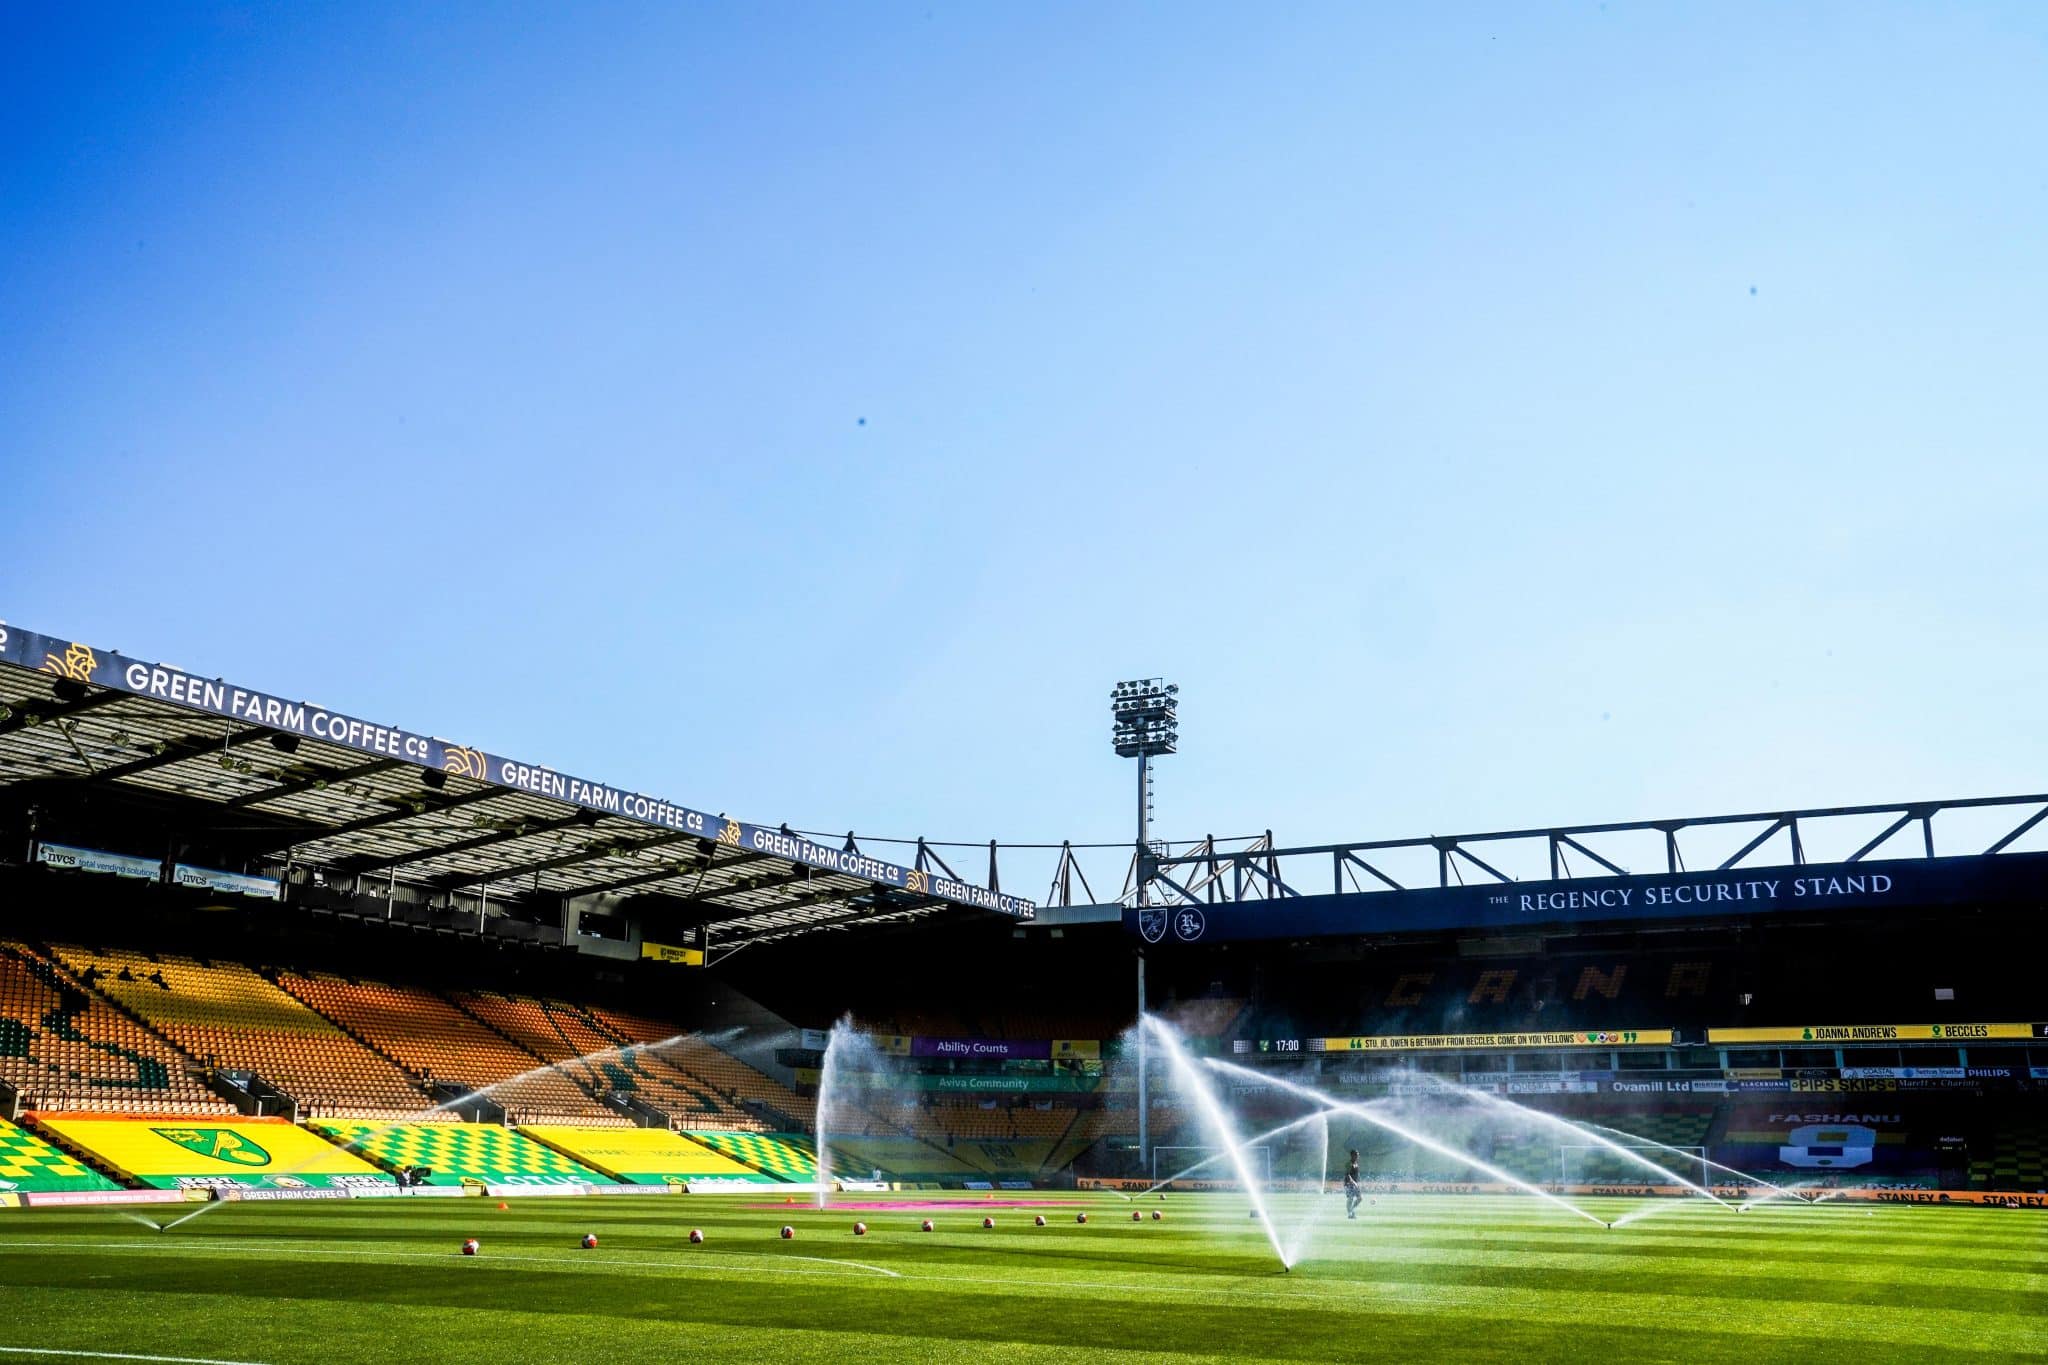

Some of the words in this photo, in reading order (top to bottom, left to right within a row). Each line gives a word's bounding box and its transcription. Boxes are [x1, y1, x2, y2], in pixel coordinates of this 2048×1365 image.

[125, 662, 225, 711] GREEN
[231, 691, 305, 732] FARM
[311, 711, 401, 756] COFFEE
[501, 762, 565, 797] GREEN
[570, 779, 619, 812] FARM
[623, 795, 684, 828] COFFEE
[754, 830, 800, 860] GREEN
[802, 843, 838, 869] FARM
[840, 854, 885, 881] COFFEE
[48, 852, 76, 865] nvcs
[79, 859, 96, 868] total
[127, 867, 158, 878] solutions
[183, 874, 208, 886] nvcs
[935, 879, 970, 902] GREEN
[971, 888, 999, 909] FARM
[1000, 896, 1035, 918] COFFEE
[1489, 895, 1510, 905] THE
[1520, 888, 1633, 912] REGENCY
[1645, 879, 1782, 906] SECURITY
[1794, 874, 1893, 898] STAND
[1816, 1027, 1850, 1039] JOANNA
[1852, 1026, 1897, 1039] ANDREWS
[1945, 1025, 1988, 1038] BECCLES
[1275, 1039, 1299, 1051] 17:00
[1390, 1038, 1409, 1048] OWEN
[1410, 1039, 1415, 1047] &
[1415, 1037, 1446, 1048] BETHANY
[1446, 1036, 1465, 1047] FROM
[1497, 1035, 1517, 1045] COME
[1518, 1034, 1527, 1044] ON
[1528, 1034, 1541, 1044] YOU
[1542, 1033, 1575, 1044] YELLOWS
[937, 1042, 970, 1055] Ability
[973, 1042, 1008, 1053] Counts
[1968, 1068, 2011, 1077] PHILIPS
[939, 1077, 967, 1088] Aviva
[969, 1077, 1029, 1090] Community
[1613, 1081, 1663, 1092] Ovamill
[1667, 1081, 1690, 1092] Ltd
[1799, 1079, 1835, 1092] PIPS
[1839, 1079, 1888, 1092] SKIPS
[1768, 1113, 1901, 1123] FASHANU
[243, 1191, 276, 1200] GREEN
[276, 1191, 303, 1200] FARM
[303, 1190, 337, 1199] COFFEE
[1877, 1193, 1935, 1202] STANLEY
[1983, 1195, 2044, 1207] STANLEY
